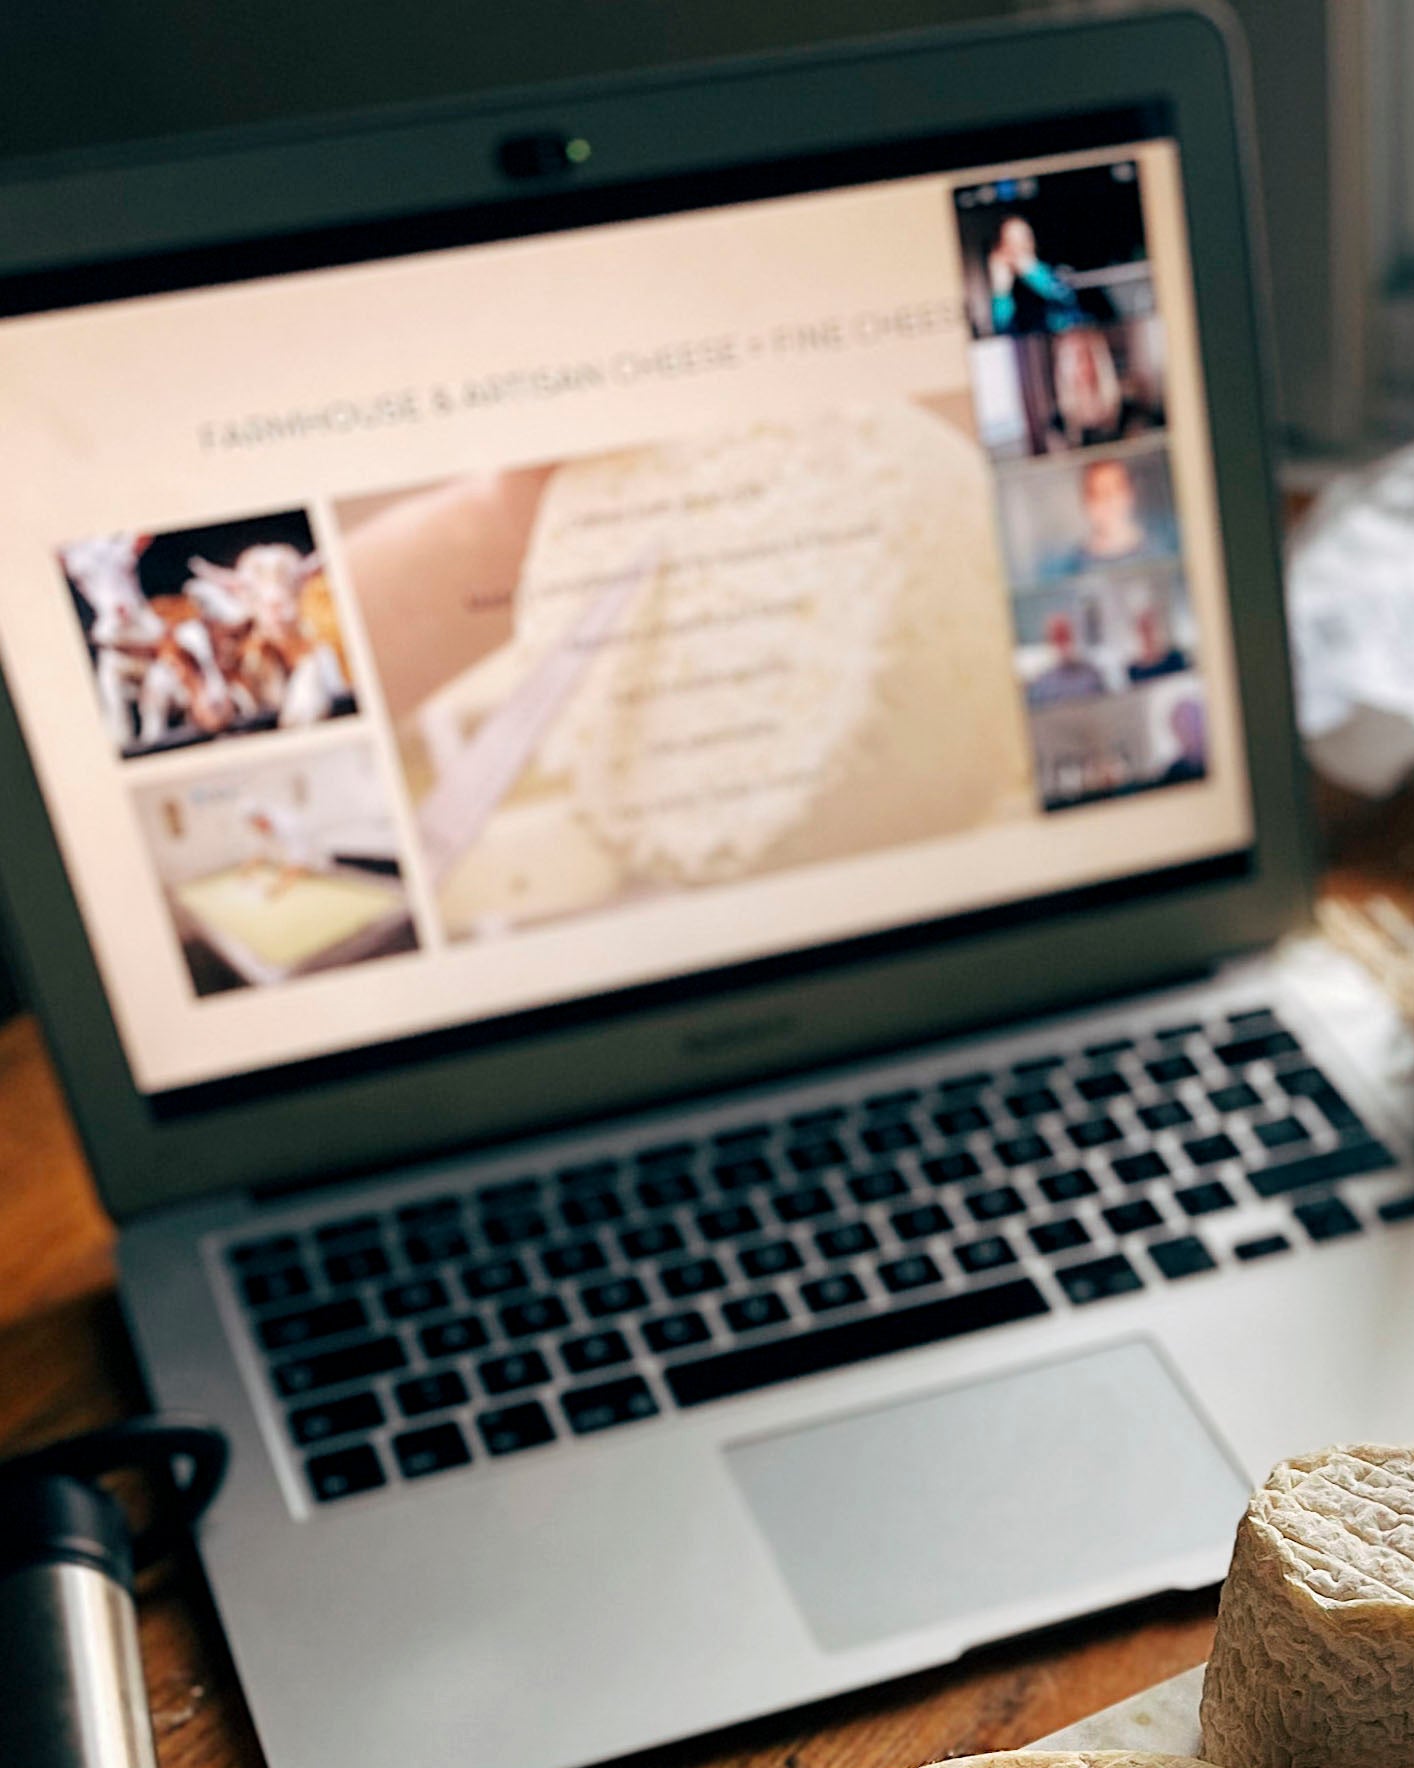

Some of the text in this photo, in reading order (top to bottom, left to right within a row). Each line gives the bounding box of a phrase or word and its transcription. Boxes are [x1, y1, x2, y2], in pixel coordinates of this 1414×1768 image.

[199, 391, 419, 450] FARMHOUSE
[461, 364, 605, 408] ARTISAN
[619, 335, 738, 383] CHEESE
